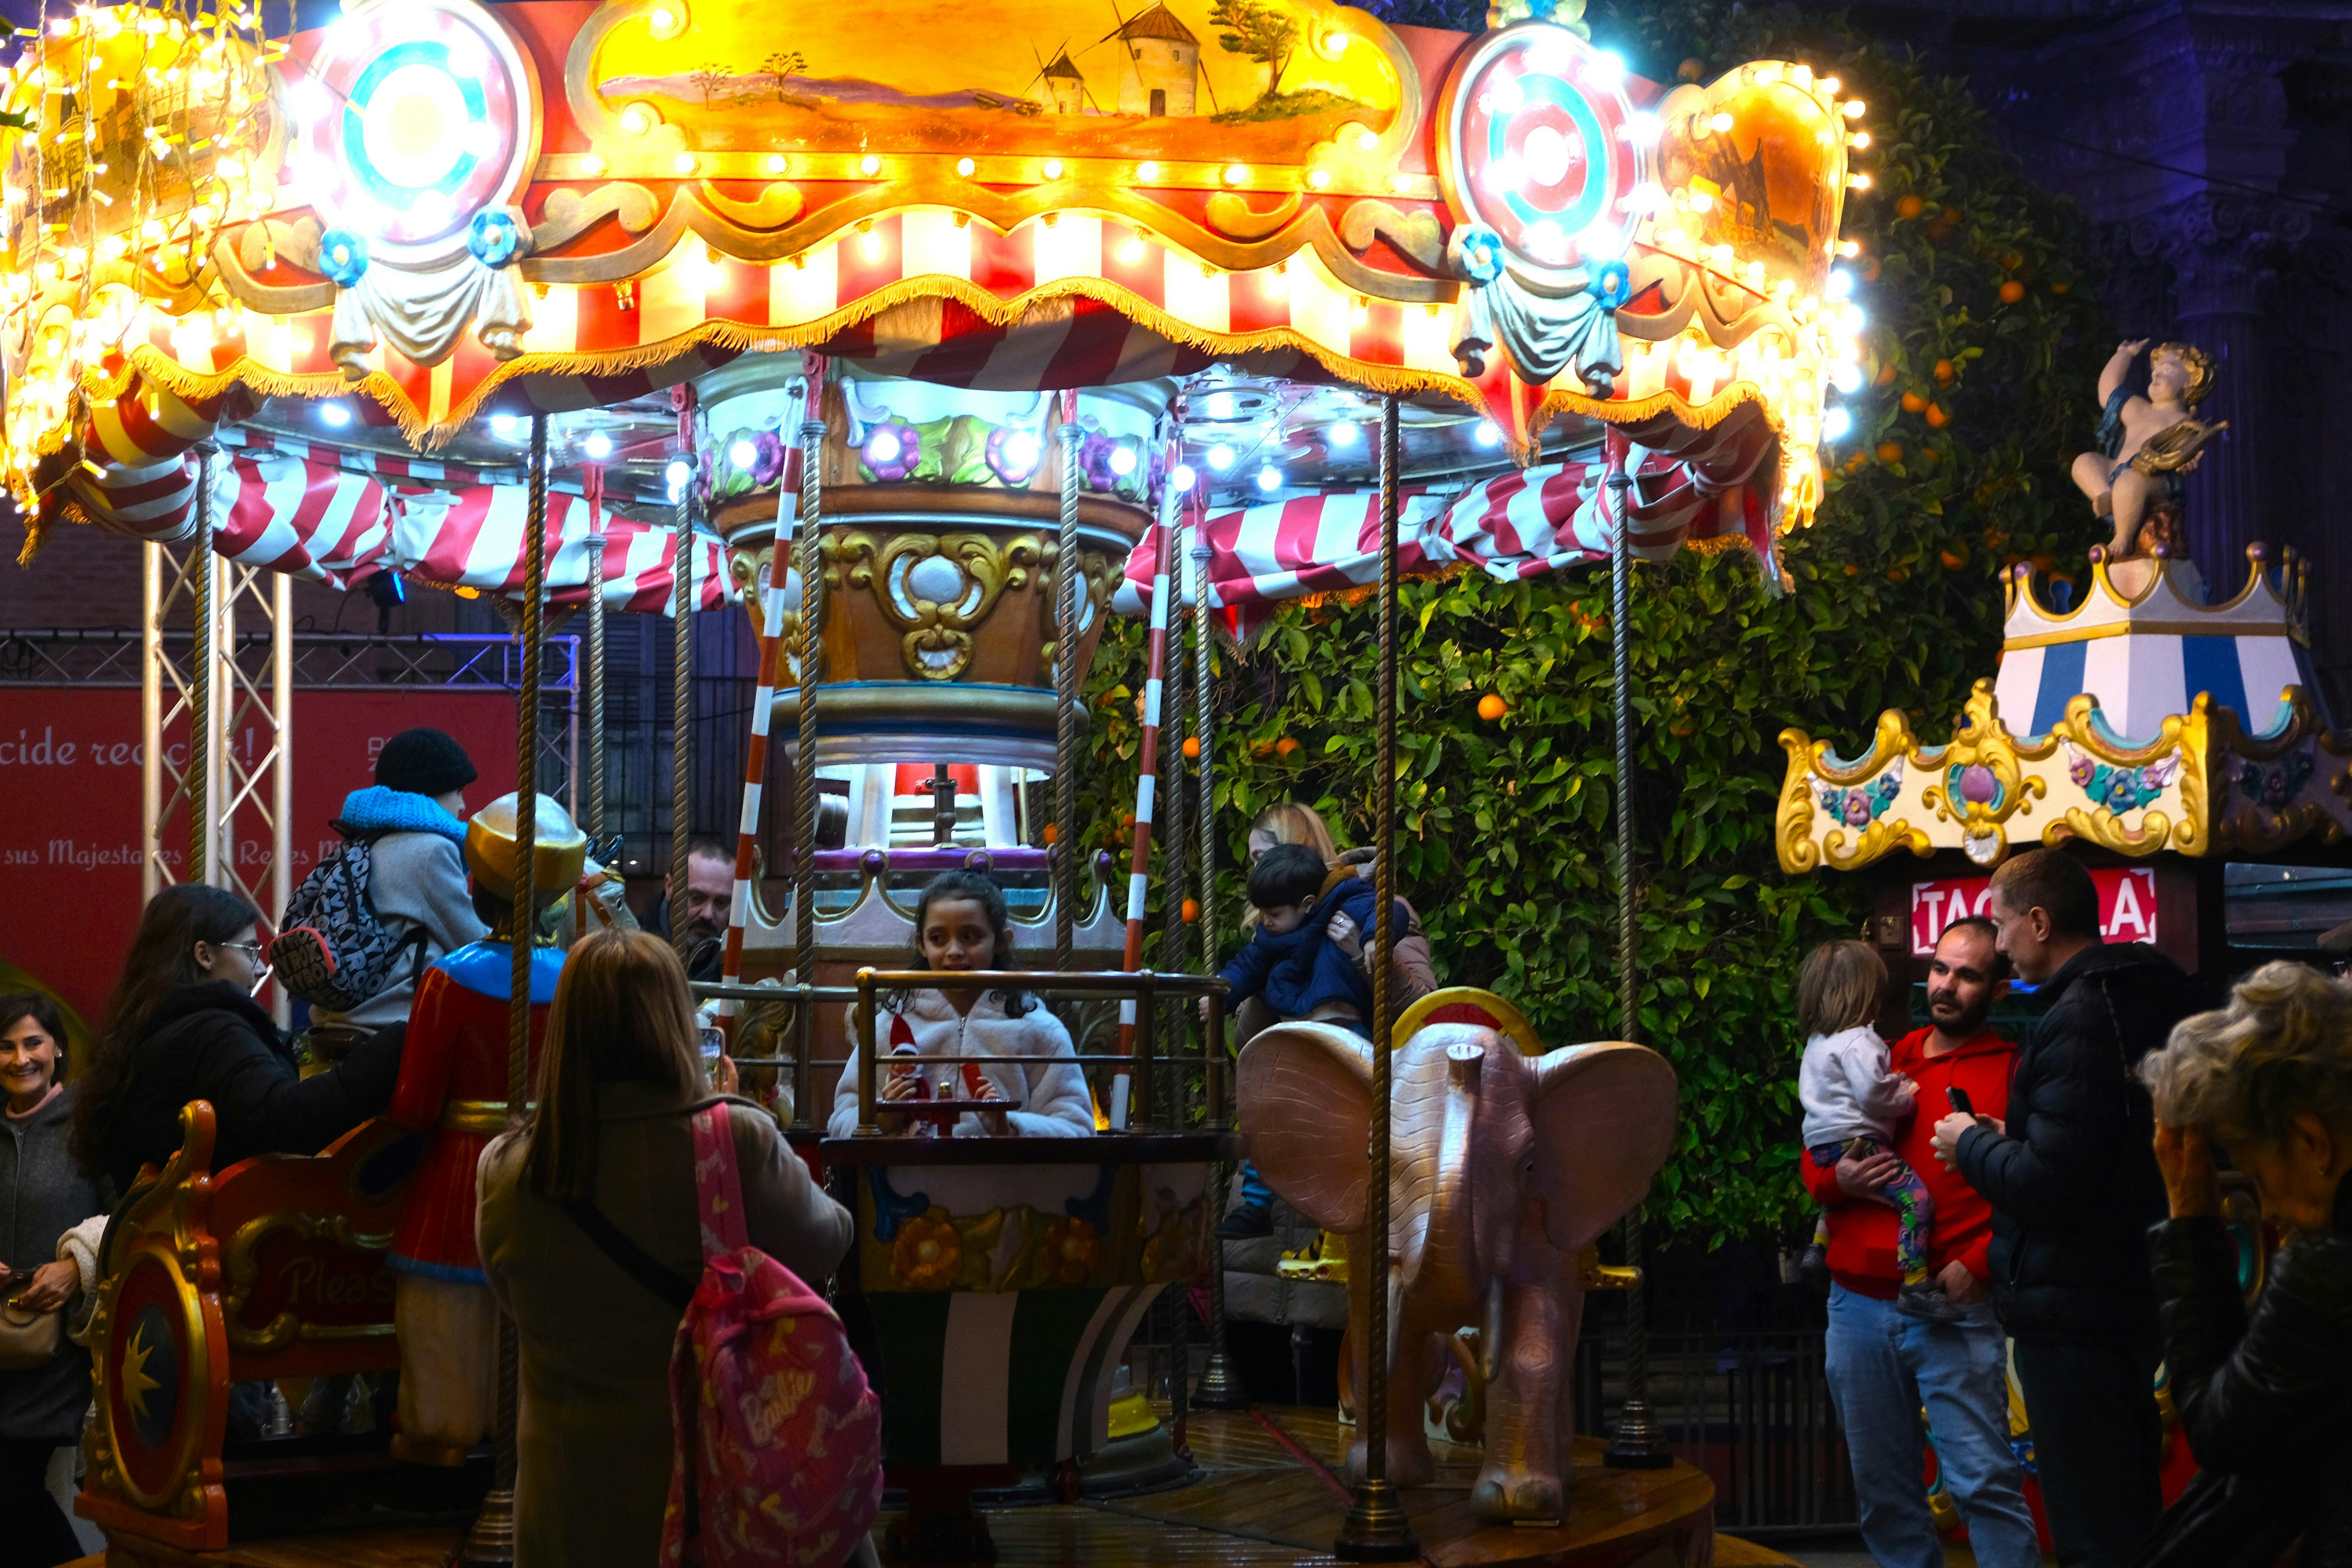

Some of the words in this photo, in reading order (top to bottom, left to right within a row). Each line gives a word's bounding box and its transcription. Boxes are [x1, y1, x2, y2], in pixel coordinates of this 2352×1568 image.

[4, 849, 38, 865] sus
[48, 839, 182, 871] Majestaes
[239, 840, 310, 865] Rees
